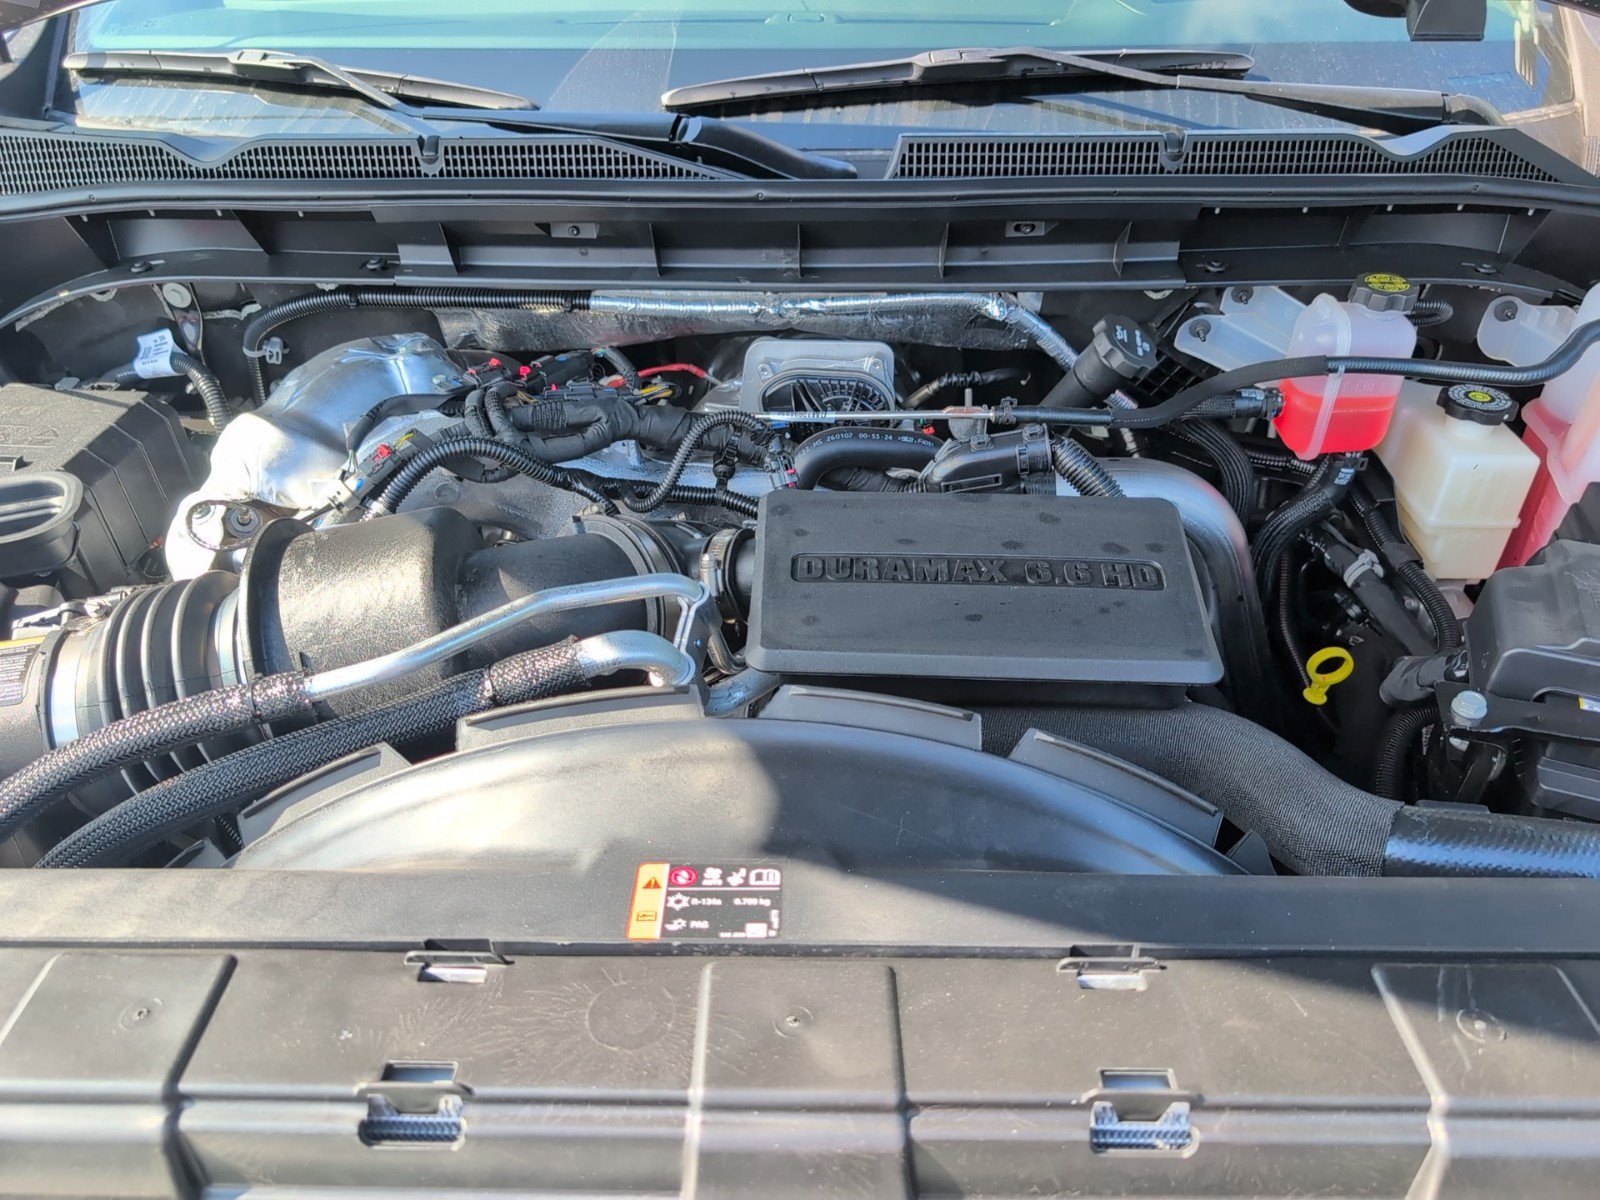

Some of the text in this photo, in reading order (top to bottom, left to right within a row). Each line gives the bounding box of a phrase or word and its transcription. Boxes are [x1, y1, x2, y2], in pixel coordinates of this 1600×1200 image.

[797, 555, 1160, 588] DURAMAX 6.6 HD
